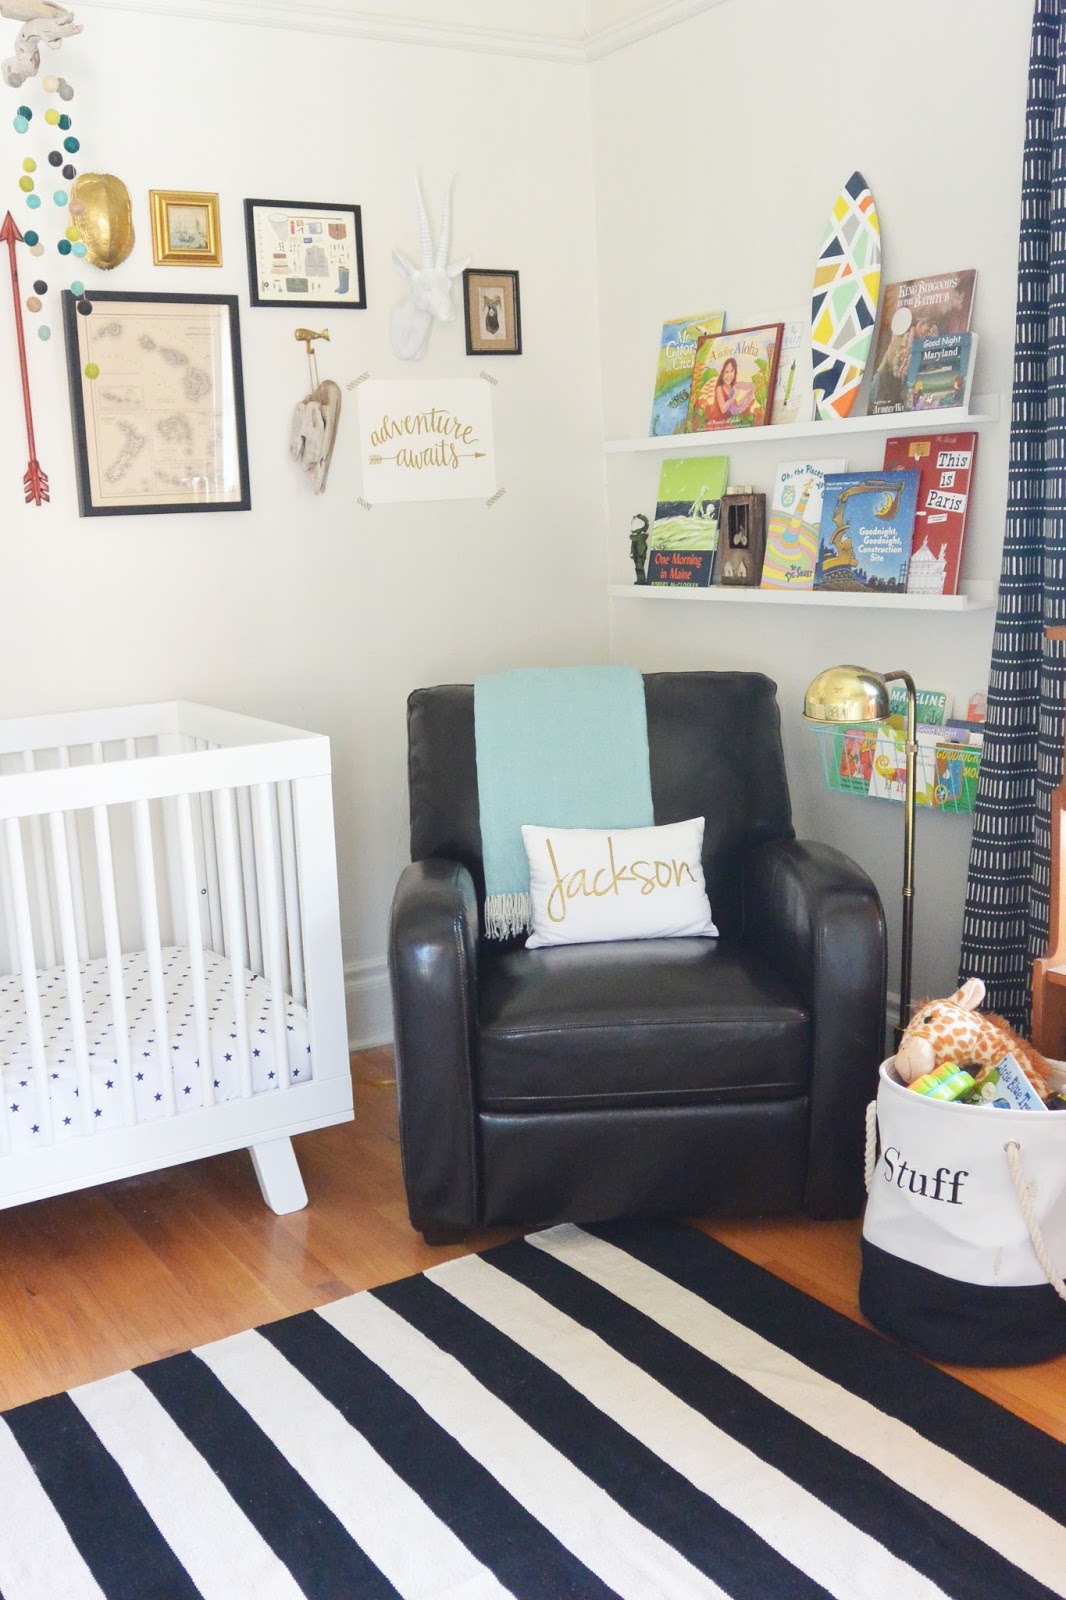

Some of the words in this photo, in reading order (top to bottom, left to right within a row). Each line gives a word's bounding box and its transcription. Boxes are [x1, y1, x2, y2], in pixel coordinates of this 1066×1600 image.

[733, 340, 759, 357] Aloha
[923, 338, 940, 348] Good
[941, 335, 961, 347] Night
[923, 347, 958, 361] Maryland
[370, 407, 480, 447] adventure
[396, 439, 459, 470] awaits
[938, 453, 968, 467] This
[794, 468, 804, 476] the
[940, 474, 953, 487] is
[927, 490, 963, 511] Paris
[859, 526, 898, 536] Goodnight,
[863, 535, 902, 546] Goodnight,
[858, 544, 902, 553] Construction
[655, 553, 670, 565] One
[672, 553, 703, 569] Morning
[870, 553, 884, 562] Site
[660, 568, 668, 579] in
[670, 567, 692, 580] Maine
[891, 690, 946, 708] MAELINE
[918, 725, 936, 735] Good
[546, 836, 698, 922] Jackson
[1006, 1076, 1023, 1101] Blue
[883, 1146, 970, 1206] Stuff
